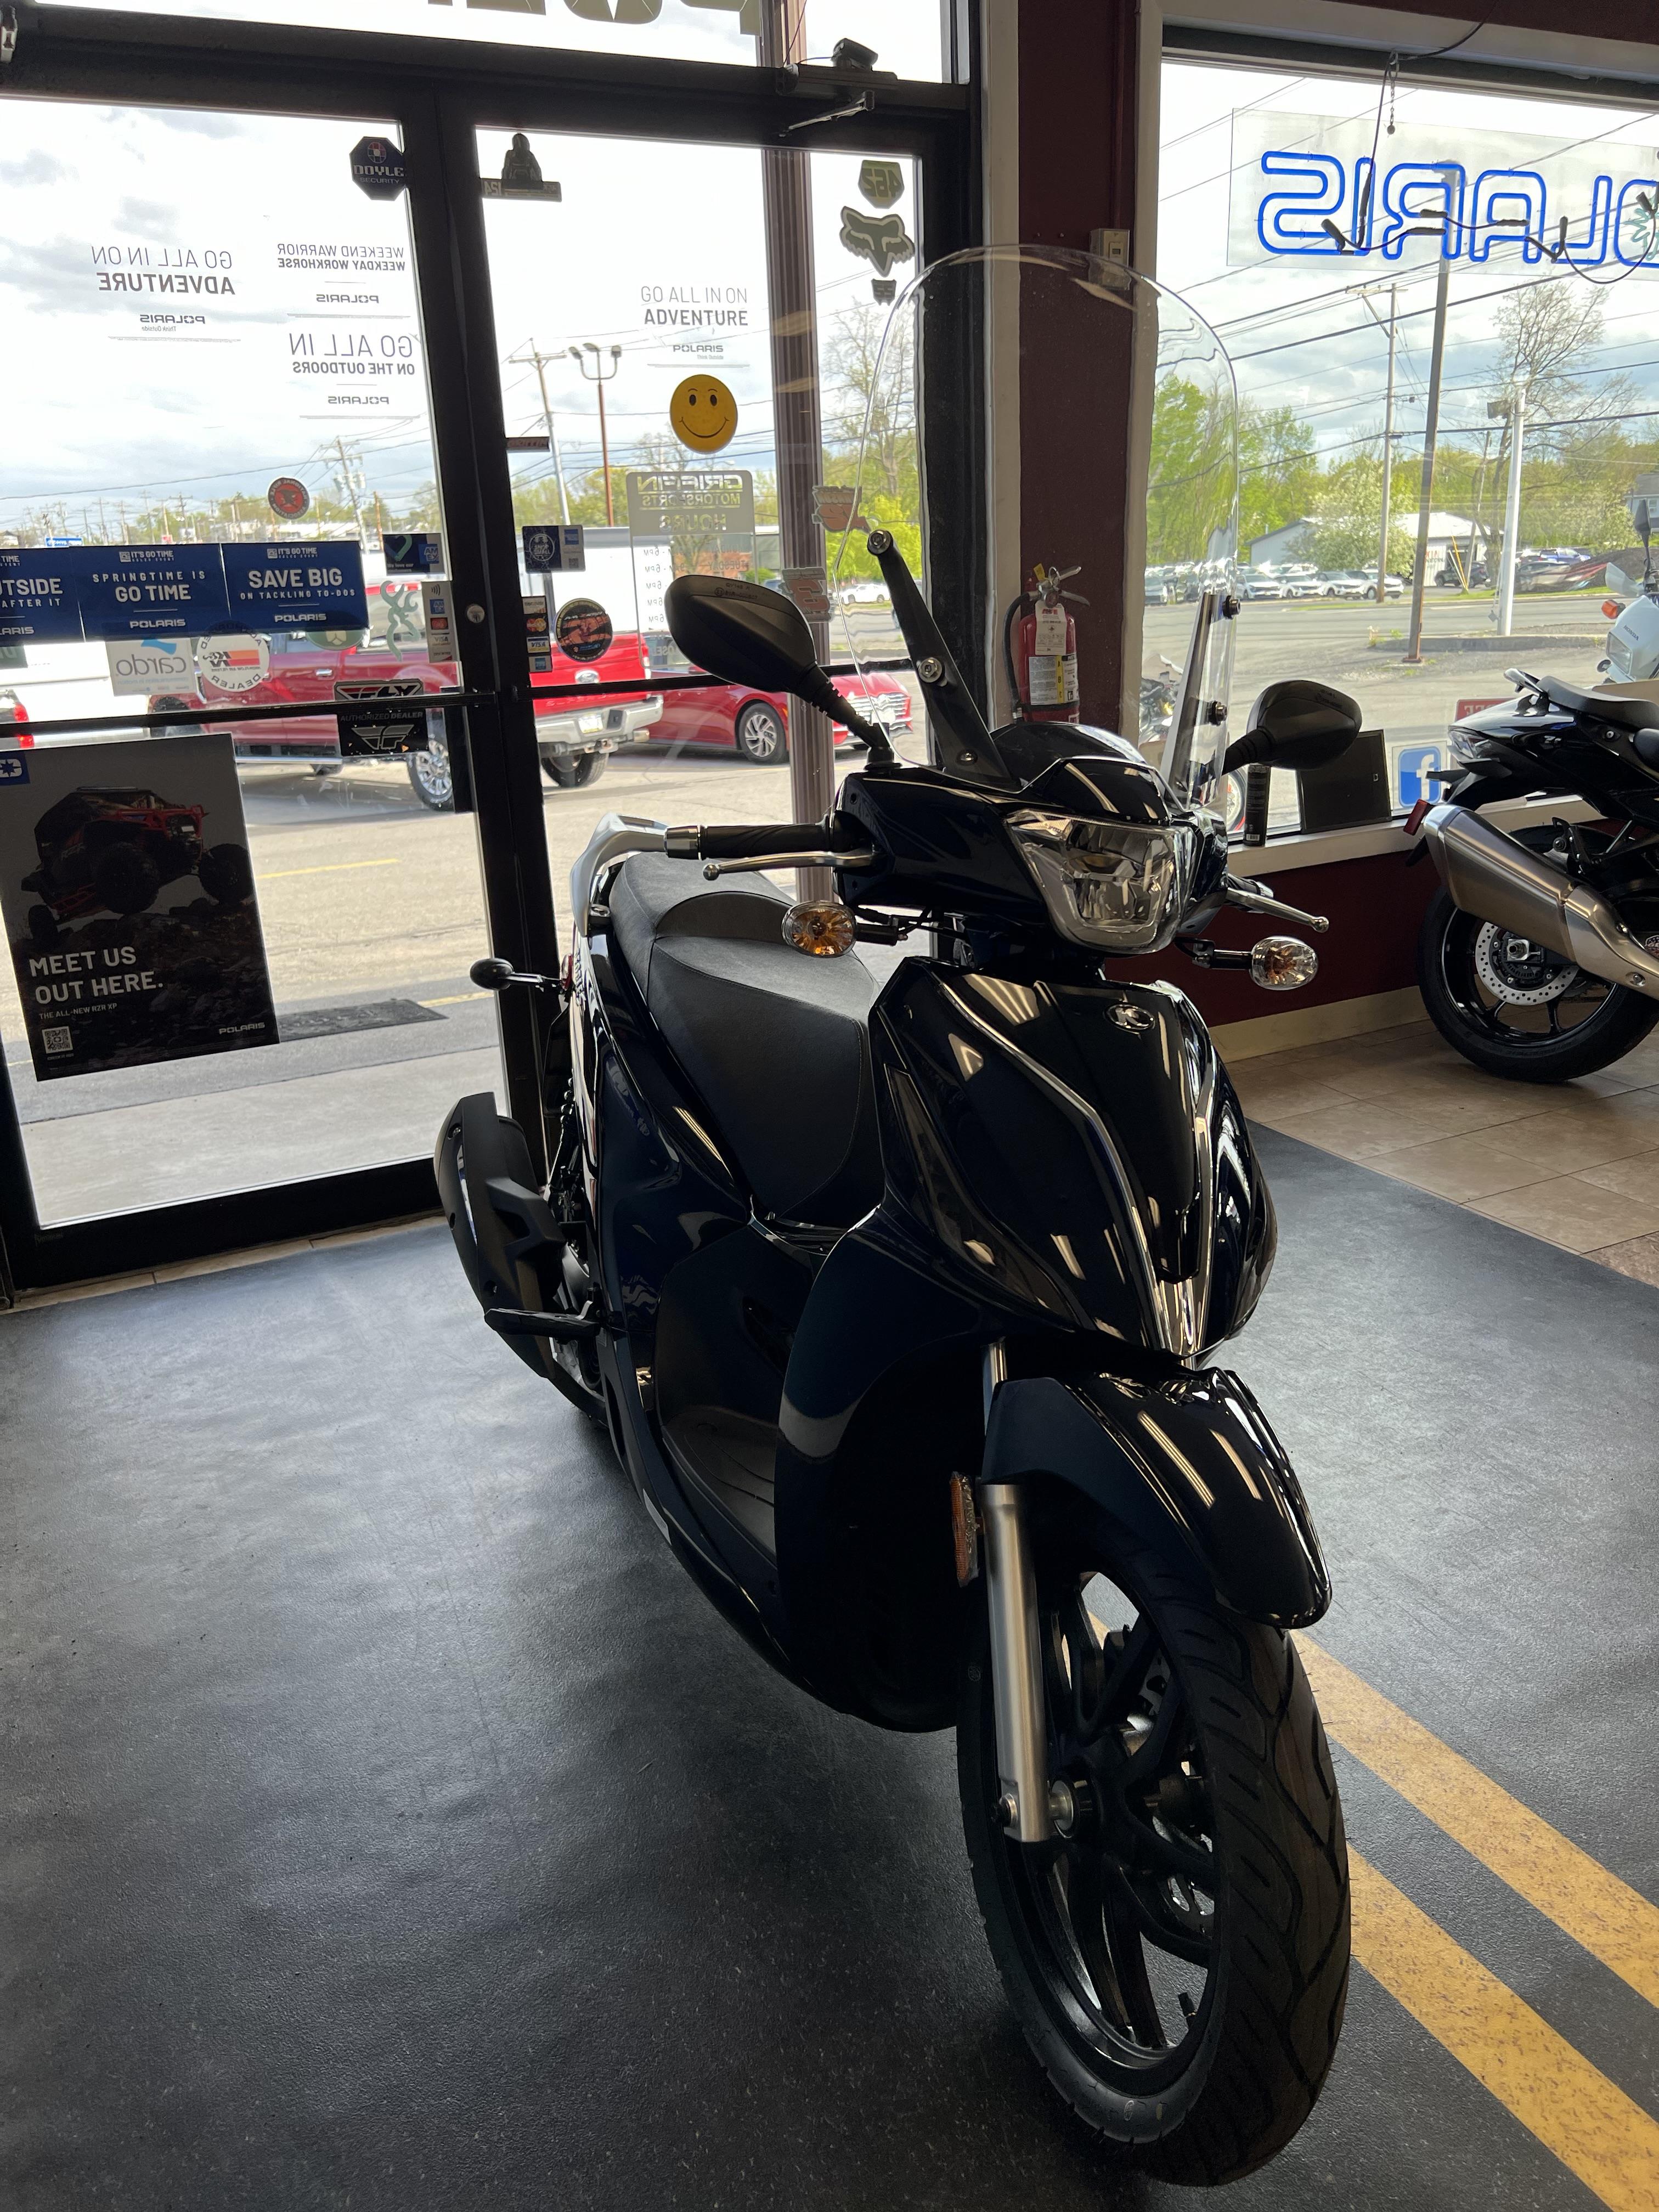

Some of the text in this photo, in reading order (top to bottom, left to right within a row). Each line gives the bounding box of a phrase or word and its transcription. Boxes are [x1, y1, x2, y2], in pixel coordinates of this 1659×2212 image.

[353, 165, 404, 177] DOYLE
[641, 286, 747, 303] GO ALL IN ON
[645, 309, 748, 326] ADVENTURE
[92, 571, 205, 583] SPRINGTIME IS
[248, 568, 343, 589] SAVE BIG
[0, 578, 63, 596] TSIDE
[115, 584, 191, 602] GO TIME
[240, 592, 253, 600] ON
[259, 590, 311, 600] TACKLING
[2, 598, 60, 608] AFTER IT
[129, 619, 186, 629] POLARIS
[274, 613, 327, 623] POLARIS
[0, 627, 34, 635] ARIS
[1623, 625, 1639, 641] HONDA
[341, 713, 390, 722] AUTHORIZED
[29, 946, 137, 977] MEET US
[35, 970, 163, 1005] OUT HERE.
[55, 1006, 90, 1018] ALL-NEW
[92, 1004, 106, 1012] RZR
[219, 1022, 266, 1035] POLARIS
